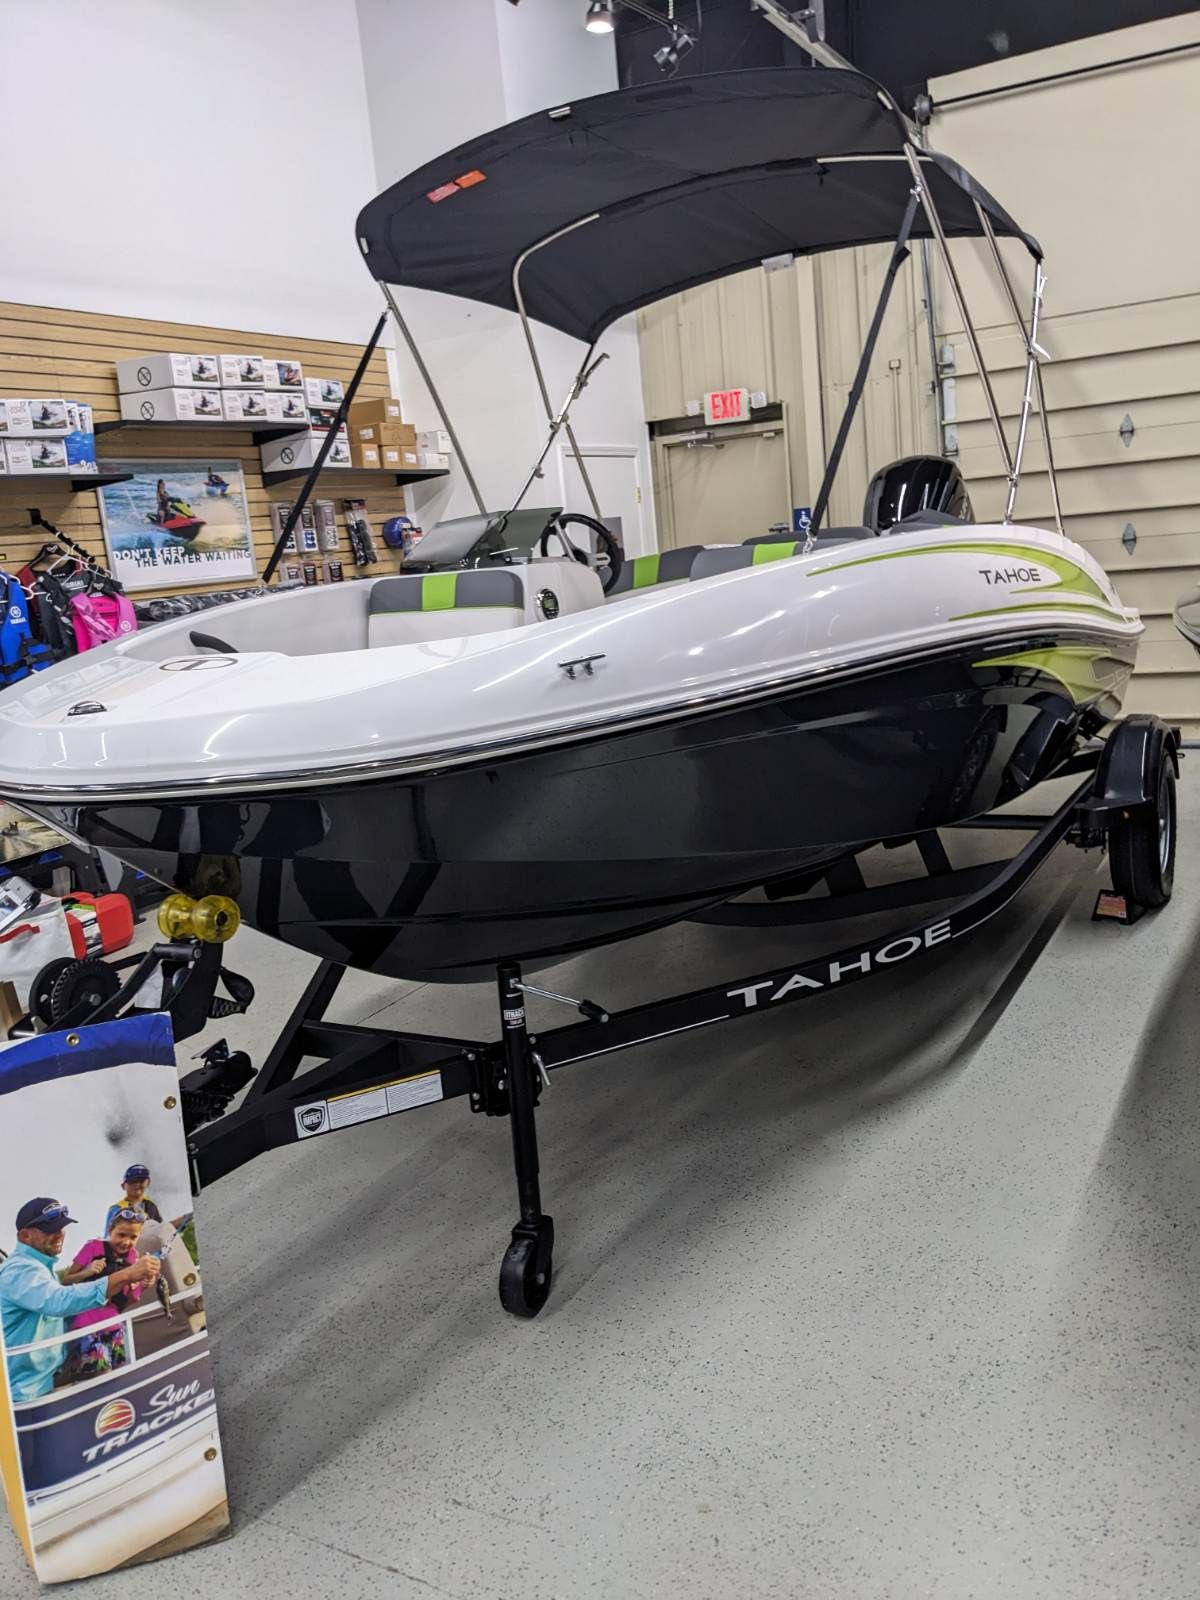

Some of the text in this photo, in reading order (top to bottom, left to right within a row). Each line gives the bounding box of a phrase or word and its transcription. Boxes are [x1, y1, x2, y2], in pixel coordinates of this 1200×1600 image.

[710, 391, 742, 420] EXIT
[113, 546, 185, 561] DON'T KEEP
[136, 550, 251, 568] THE WATER WAITING
[978, 568, 1041, 585] TAHOE
[726, 919, 951, 1008] TAHOE
[141, 1379, 201, 1417] Sun
